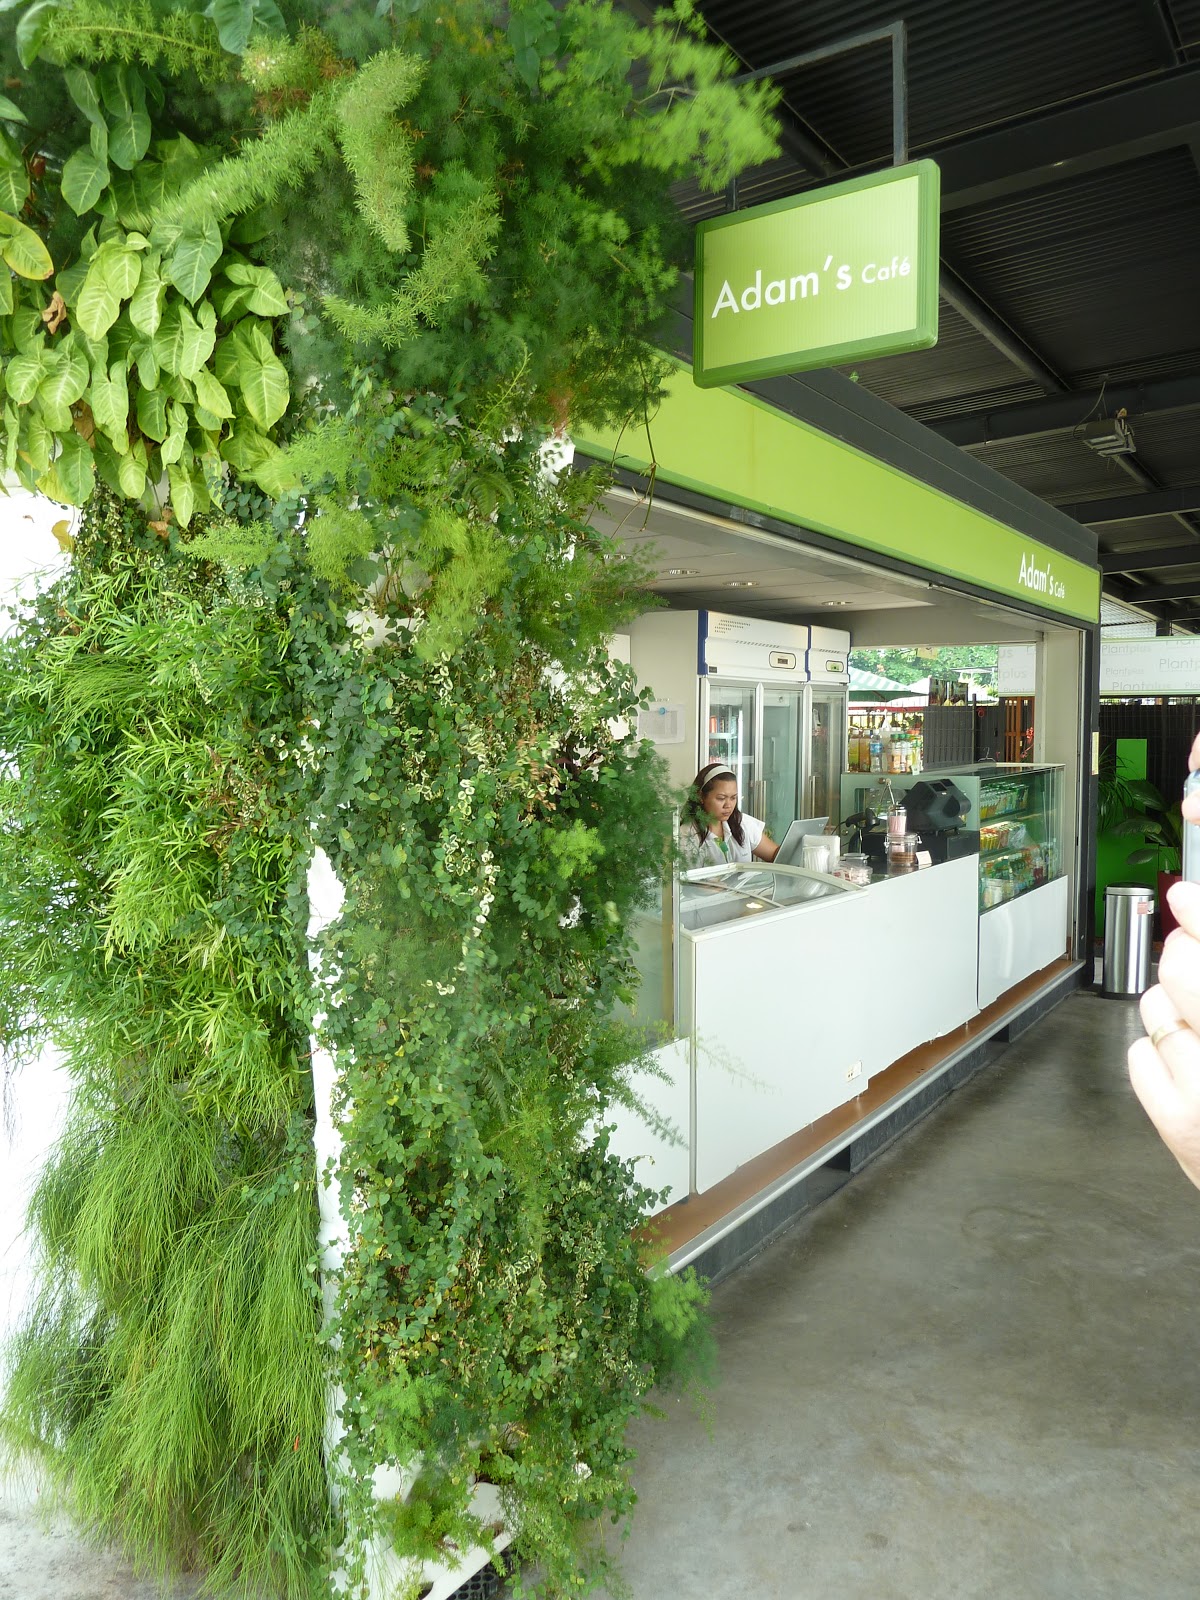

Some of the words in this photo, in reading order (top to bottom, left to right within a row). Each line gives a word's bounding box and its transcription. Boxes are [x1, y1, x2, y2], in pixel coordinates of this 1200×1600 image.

[711, 255, 851, 319] Adam's
[861, 256, 911, 284] Café
[1018, 552, 1054, 596] Adam's
